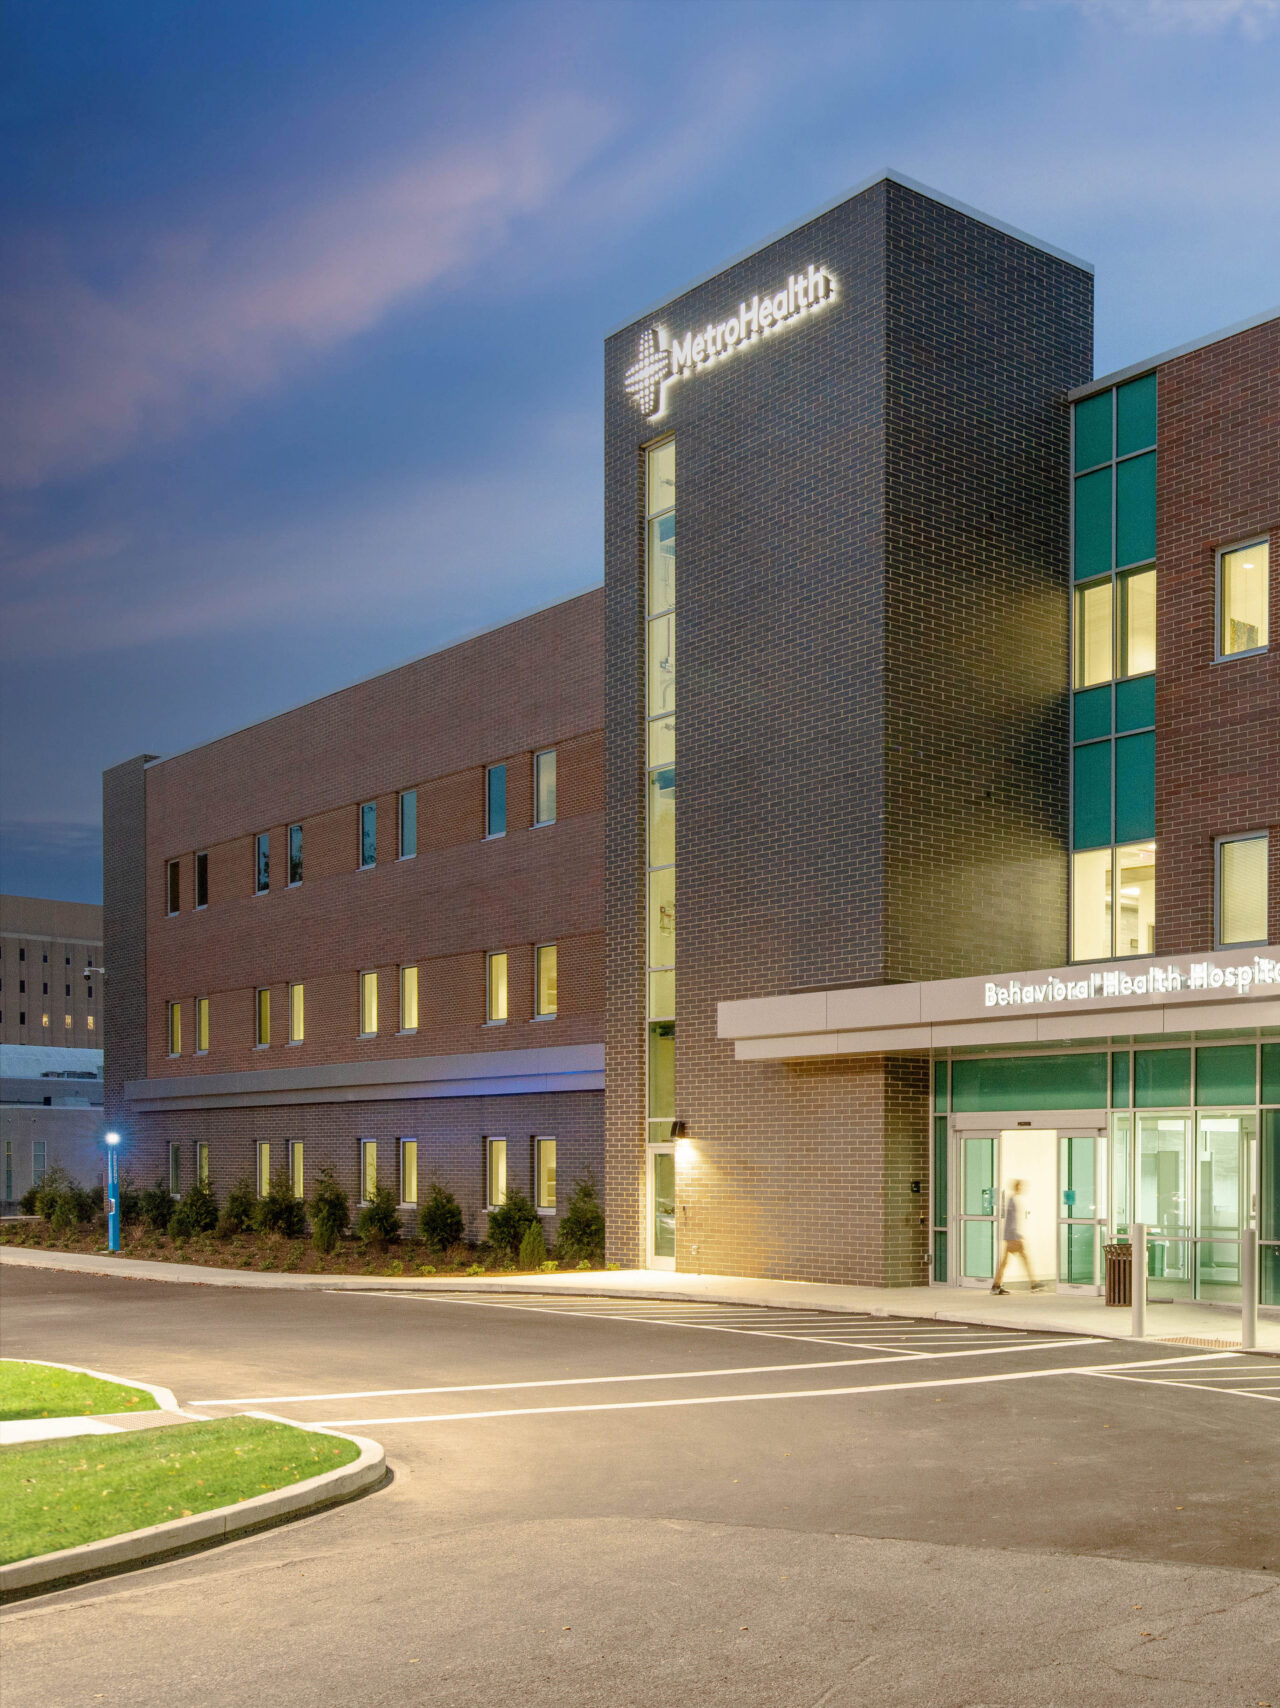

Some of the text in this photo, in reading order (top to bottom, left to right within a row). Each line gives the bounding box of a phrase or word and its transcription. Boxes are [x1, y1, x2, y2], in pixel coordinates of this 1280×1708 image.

[672, 264, 826, 375] MetroHealth
[985, 973, 1096, 1006] Behavioral
[1103, 965, 1181, 997] Health
